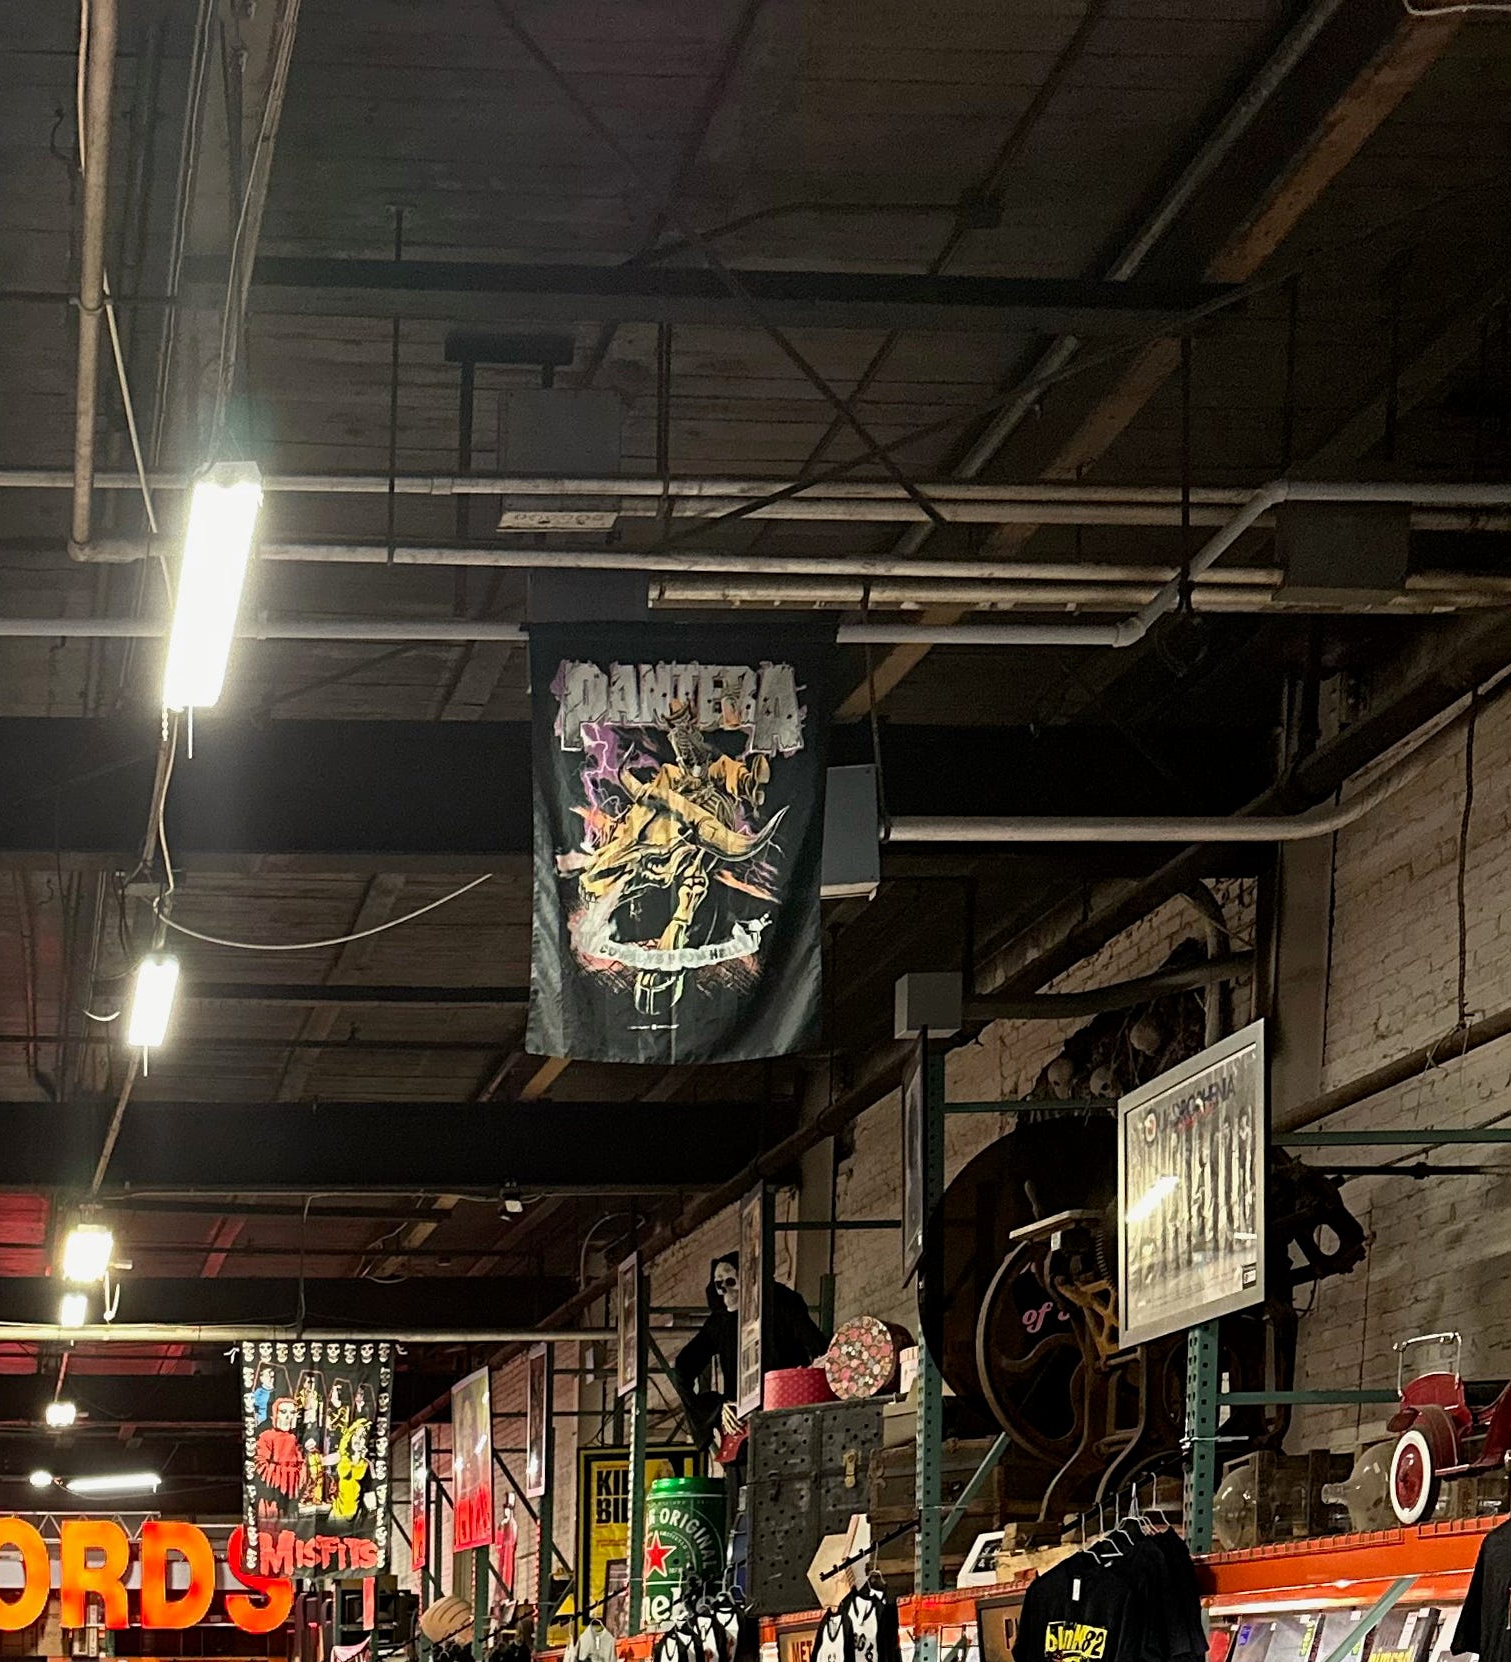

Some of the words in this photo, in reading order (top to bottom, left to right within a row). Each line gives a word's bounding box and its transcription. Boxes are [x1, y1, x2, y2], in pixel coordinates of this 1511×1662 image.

[551, 660, 805, 754] PANTERA
[1022, 1302, 1052, 1333] of
[258, 1530, 378, 1576] MISFITS
[659, 1507, 718, 1570] ORIGINAL
